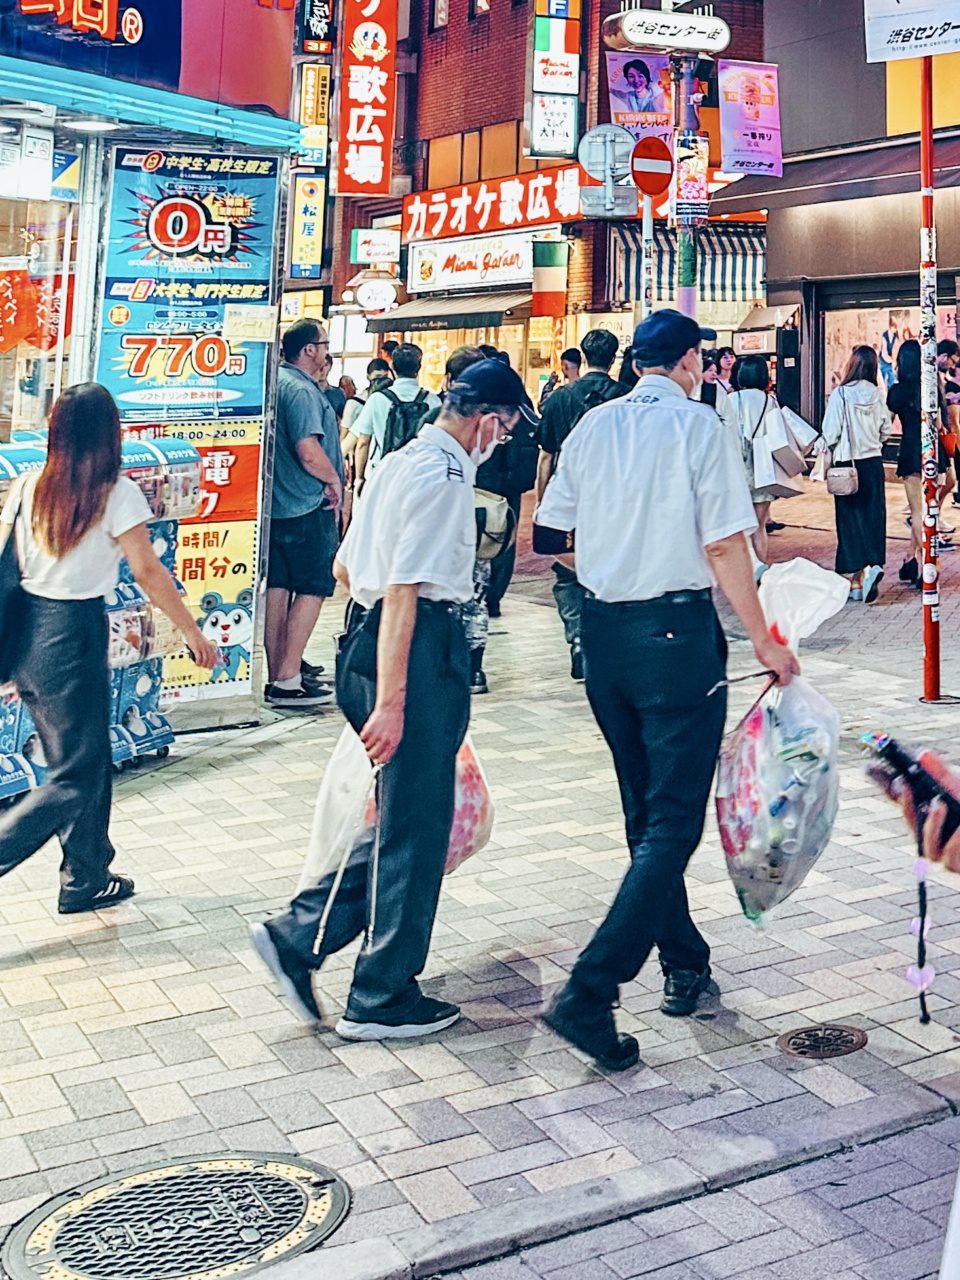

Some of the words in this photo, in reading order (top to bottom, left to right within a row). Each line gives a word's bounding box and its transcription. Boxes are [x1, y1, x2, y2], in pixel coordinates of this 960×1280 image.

[344, 64, 389, 184] 歌広場
[405, 167, 581, 238] カラオケ歌広場
[441, 252, 478, 274] Miami
[121, 333, 246, 377] 770円
